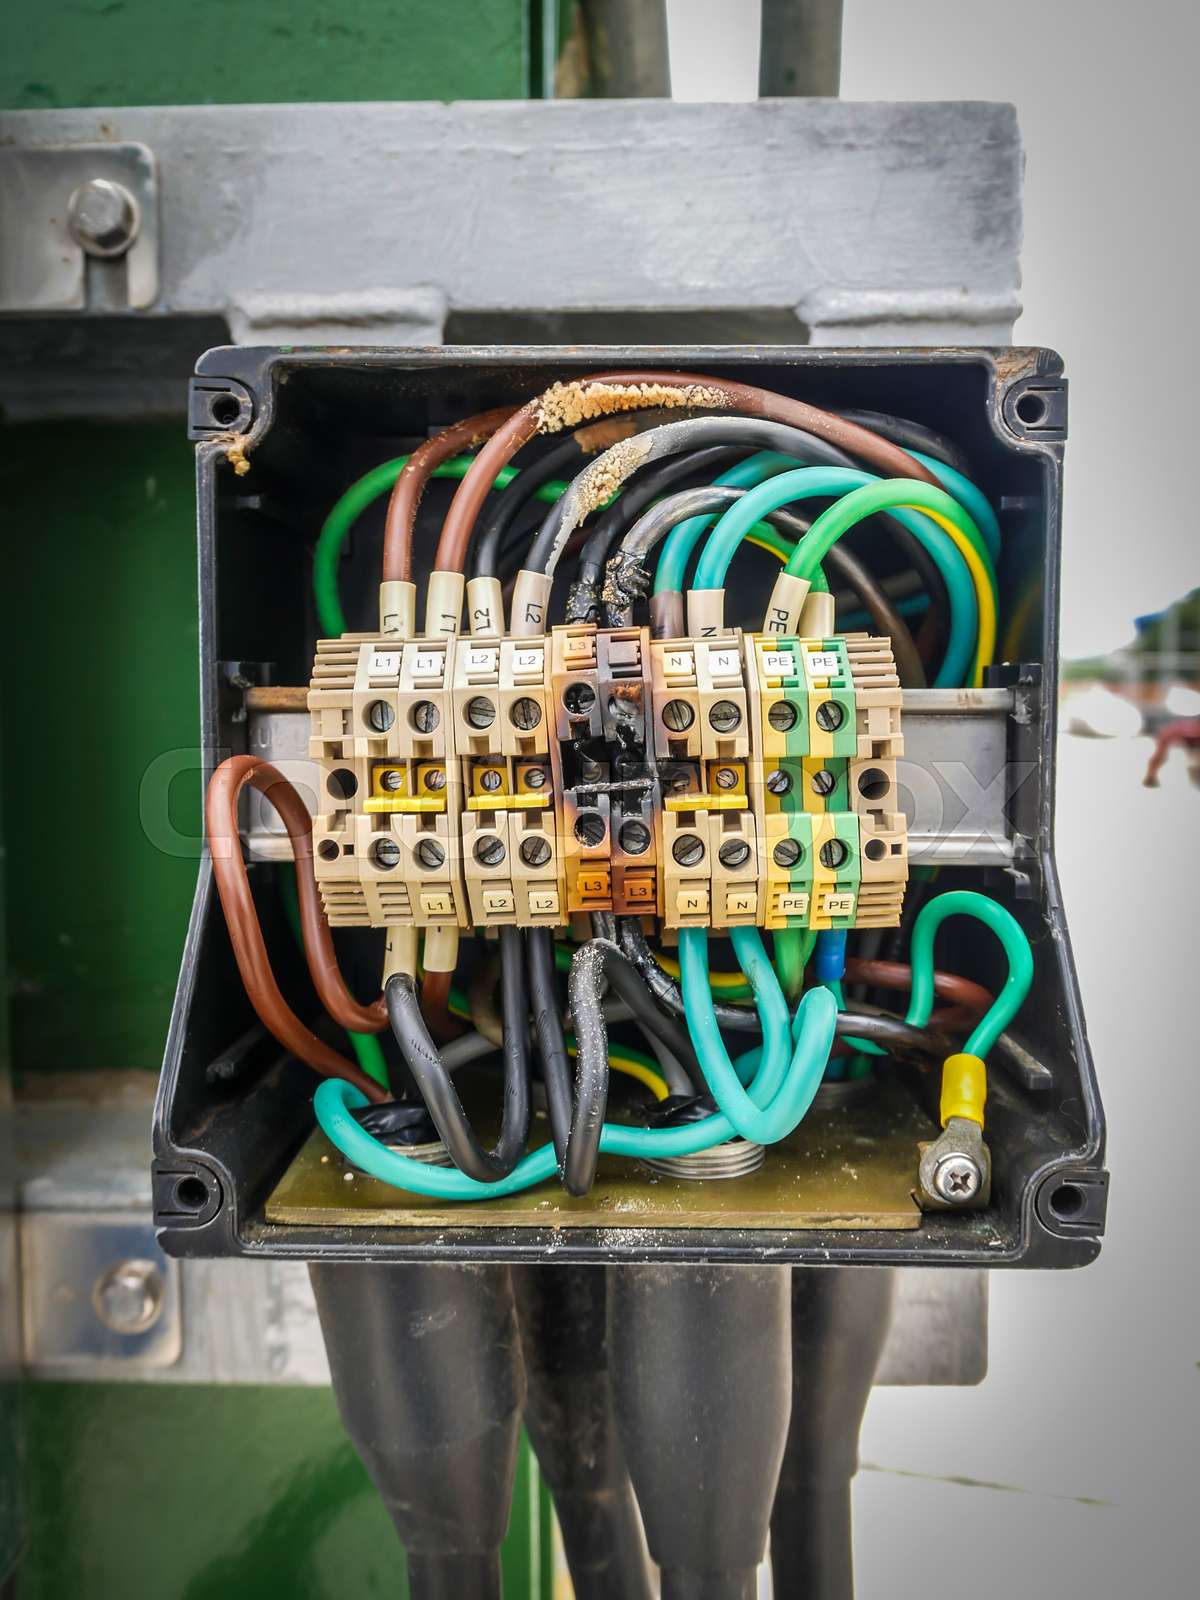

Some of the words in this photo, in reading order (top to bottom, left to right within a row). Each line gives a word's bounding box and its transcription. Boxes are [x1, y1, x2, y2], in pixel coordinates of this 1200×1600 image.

[526, 603, 543, 624] L2
[384, 614, 399, 634] L1
[440, 614, 456, 632] L1
[474, 608, 490, 631] L2
[769, 608, 790, 634] PE
[569, 641, 586, 651] L3
[375, 658, 391, 668] L1
[417, 659, 433, 669] L1
[471, 654, 489, 664] L2
[519, 655, 536, 665] L2
[671, 657, 682, 667] N
[718, 656, 729, 666] N
[768, 657, 788, 667] PE
[812, 657, 833, 667] PE
[584, 881, 602, 891] L3
[630, 887, 647, 897] L3
[427, 902, 444, 911] L1
[490, 899, 507, 908] L2
[536, 900, 554, 909] L2
[687, 899, 698, 909] N
[737, 900, 748, 910] N
[783, 899, 804, 909] PE
[829, 900, 850, 910] PE
